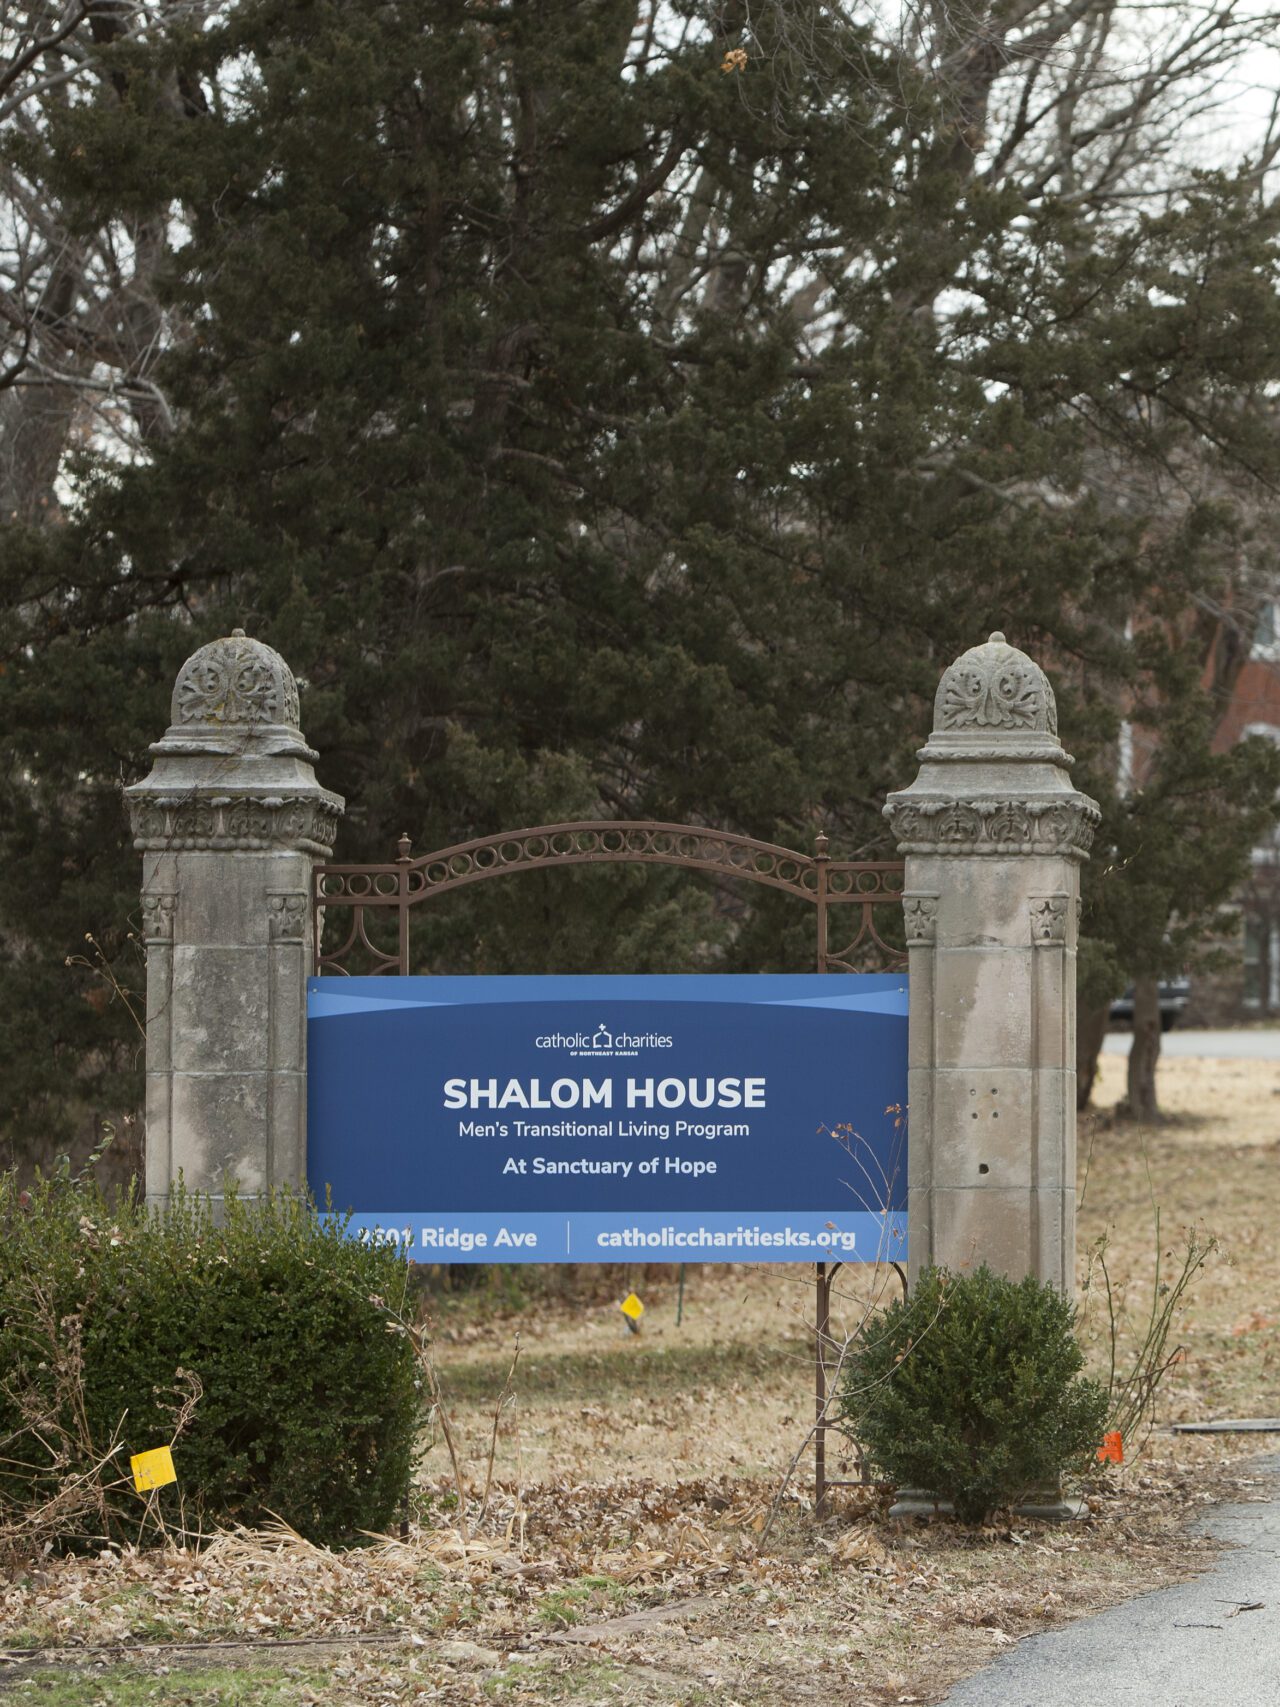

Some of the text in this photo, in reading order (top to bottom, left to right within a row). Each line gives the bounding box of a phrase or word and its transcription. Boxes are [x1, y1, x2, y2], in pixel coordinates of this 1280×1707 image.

[535, 1032, 673, 1049] catholic charities
[443, 1077, 766, 1109] SHALOM HOUSE
[513, 1120, 613, 1137] Transitional
[618, 1120, 670, 1140] Living
[675, 1120, 750, 1140] Program
[502, 1156, 717, 1178] At Sanctuary of Hope
[421, 1227, 488, 1252] Ridge
[493, 1227, 537, 1248] Ave
[596, 1227, 856, 1251] catholiccharitiesks.org
